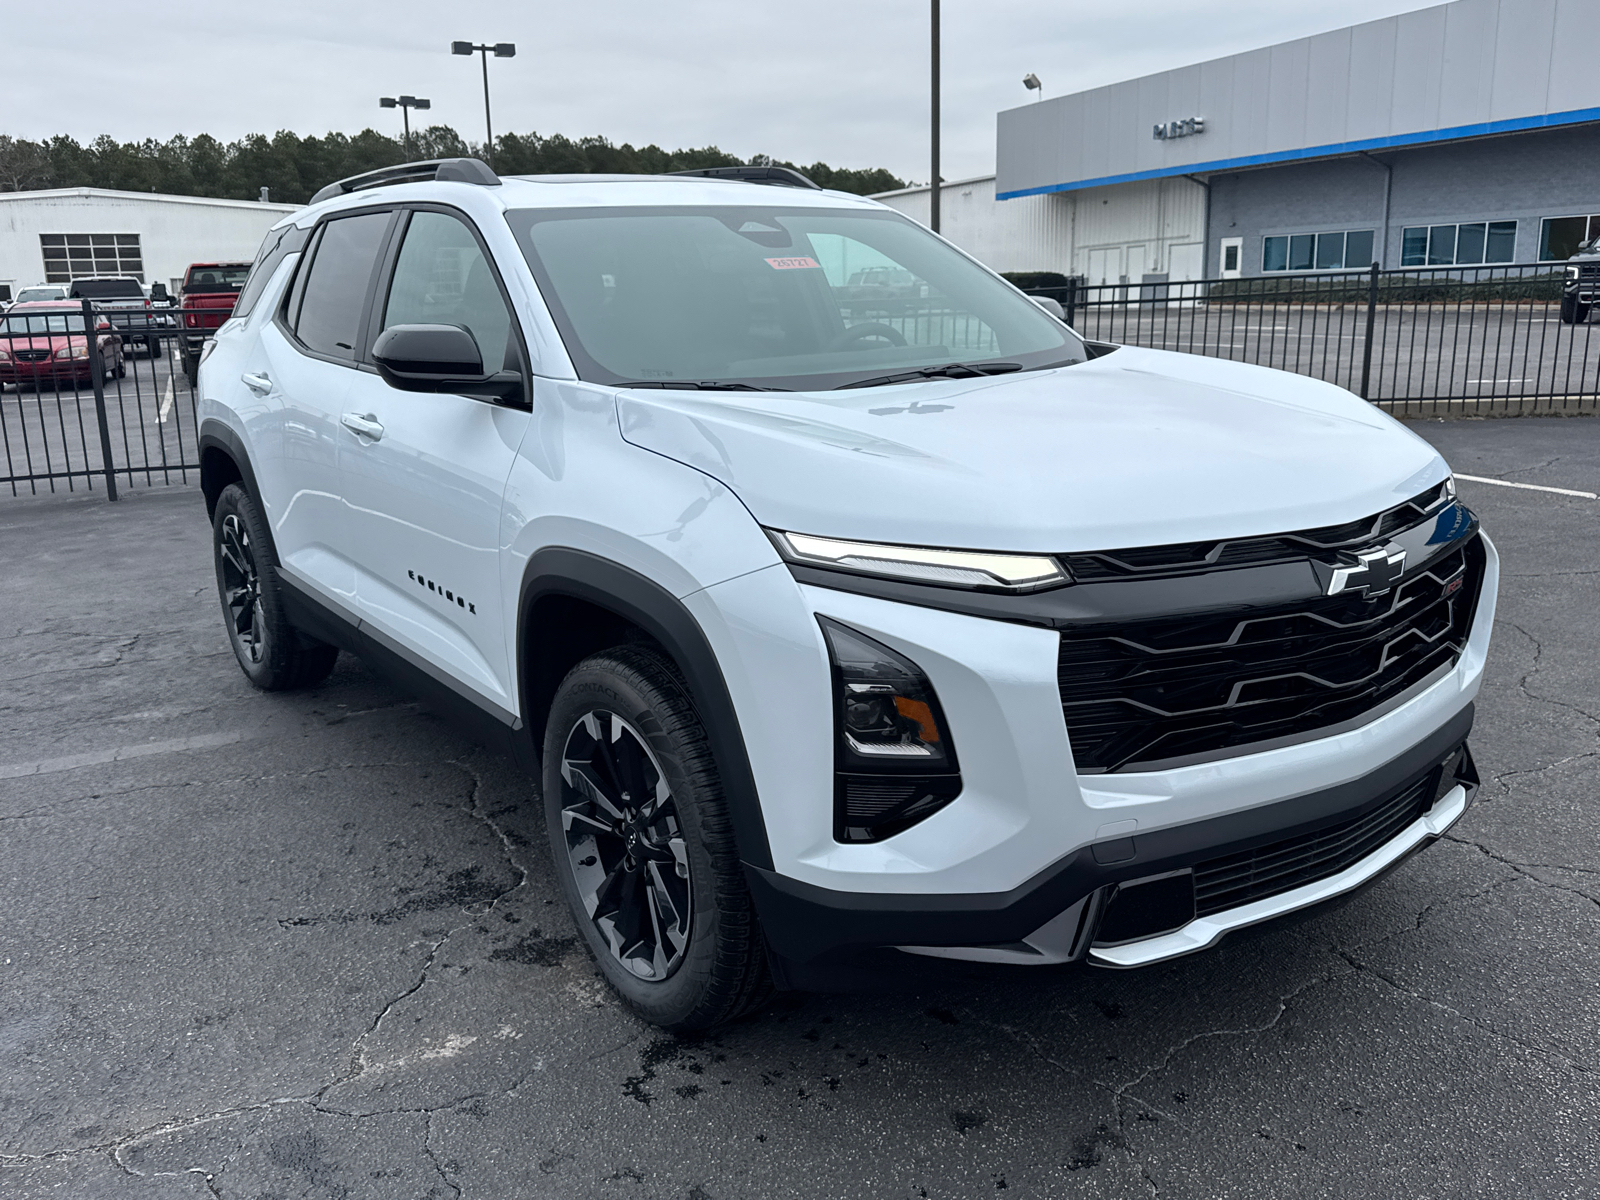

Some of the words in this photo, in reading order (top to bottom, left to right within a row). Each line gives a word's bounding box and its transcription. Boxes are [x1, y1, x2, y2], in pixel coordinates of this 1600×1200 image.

[772, 258, 810, 267] 26727
[407, 569, 477, 615] EQUINOX
[1446, 579, 1463, 593] RS
